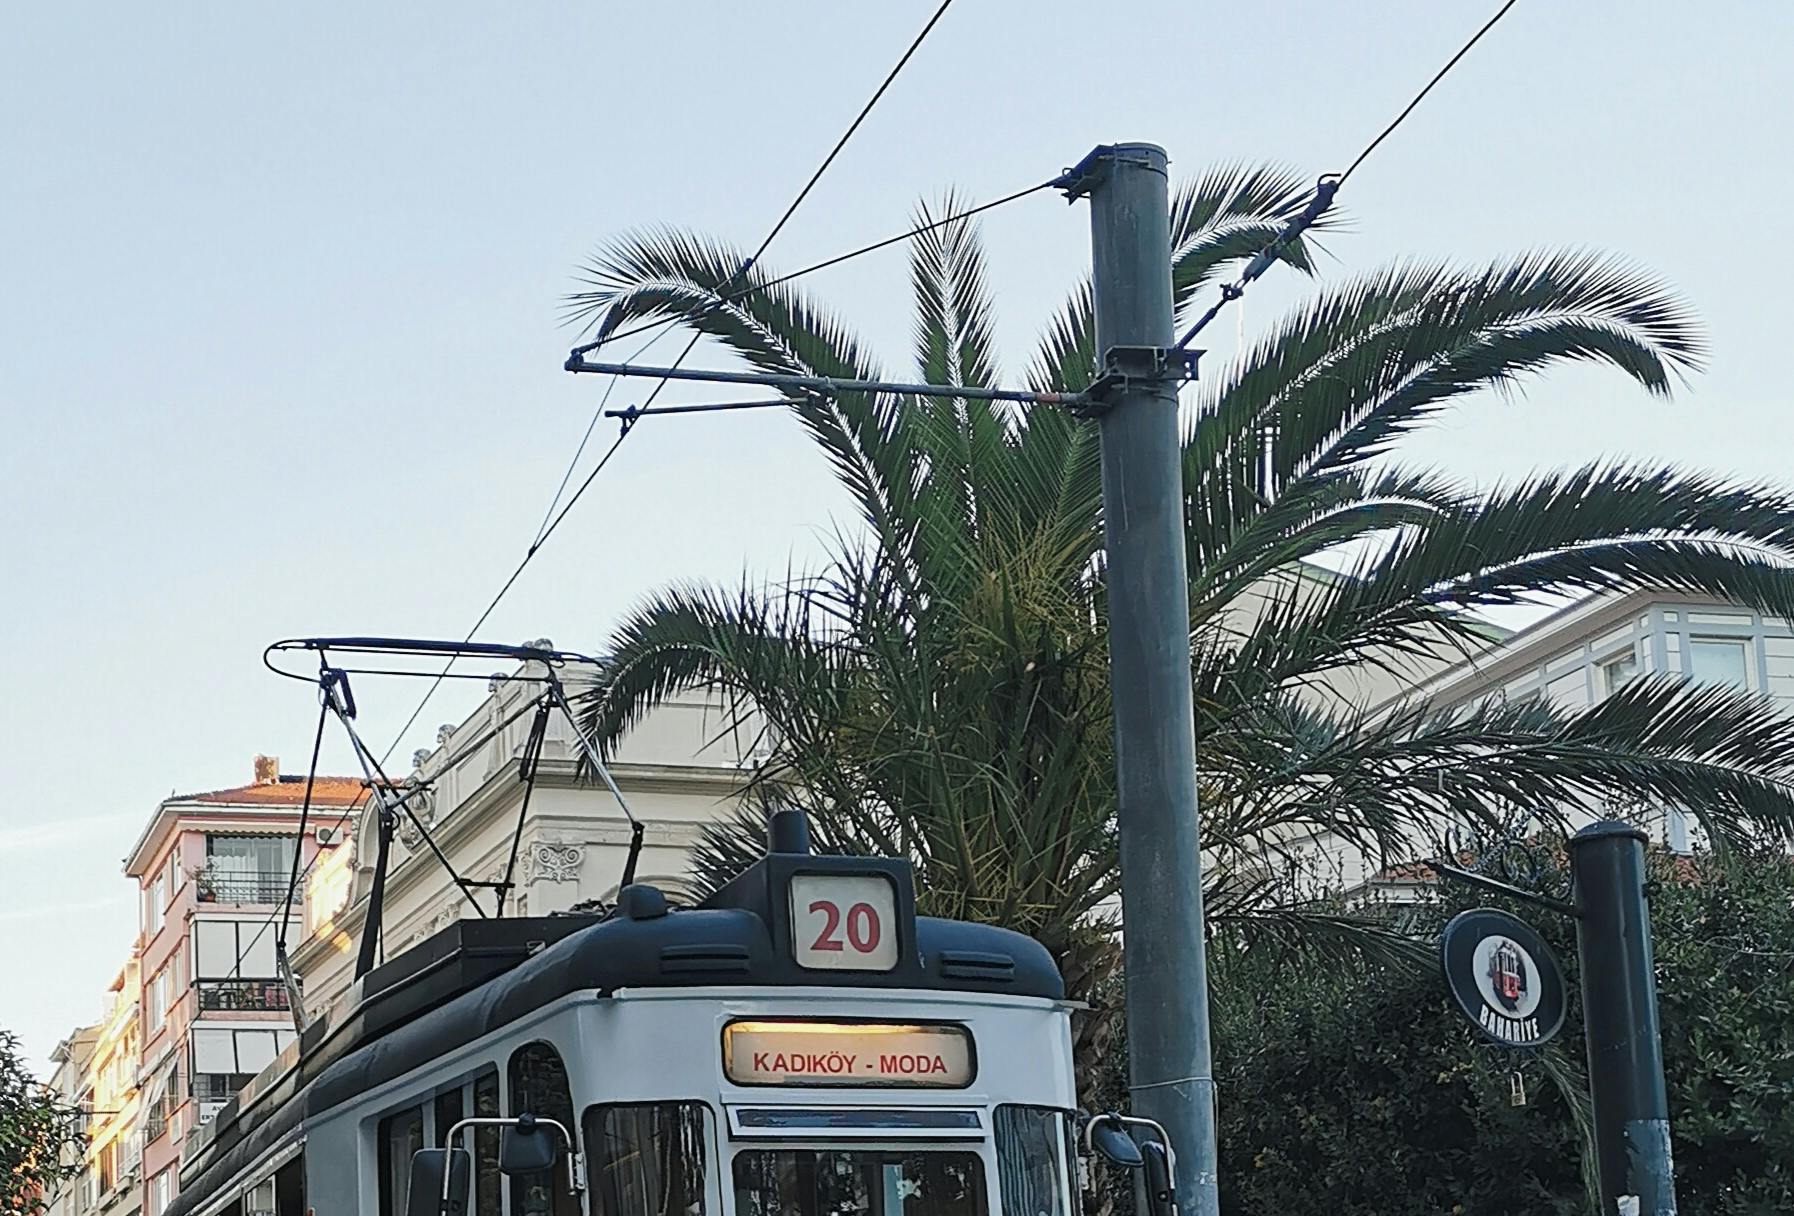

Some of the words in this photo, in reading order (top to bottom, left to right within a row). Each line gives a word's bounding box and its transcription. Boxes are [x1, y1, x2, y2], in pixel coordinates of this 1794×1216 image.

[808, 901, 881, 953] 20
[1480, 1003, 1540, 1042] BAHARİYE
[753, 1050, 857, 1073] KADIKÖY
[880, 1055, 947, 1073] MODA
